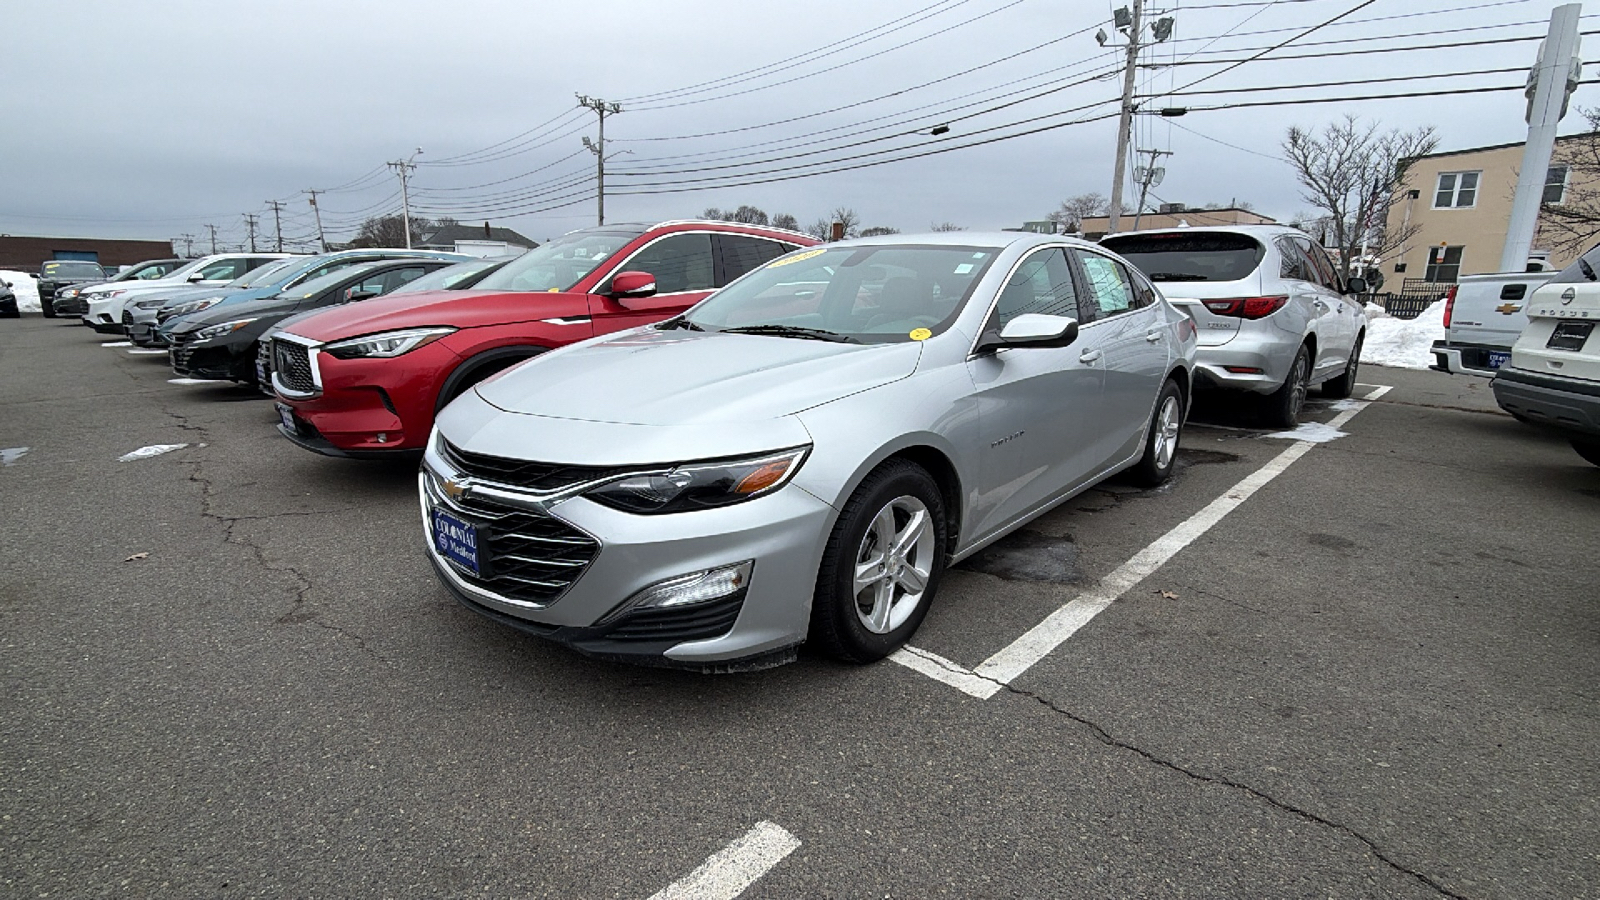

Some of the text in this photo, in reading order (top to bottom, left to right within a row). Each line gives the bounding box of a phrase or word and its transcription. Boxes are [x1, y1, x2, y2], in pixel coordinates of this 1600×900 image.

[1540, 309, 1589, 317] ROGUE
[435, 517, 477, 549] COLONIAL
[449, 539, 477, 563] Medford
